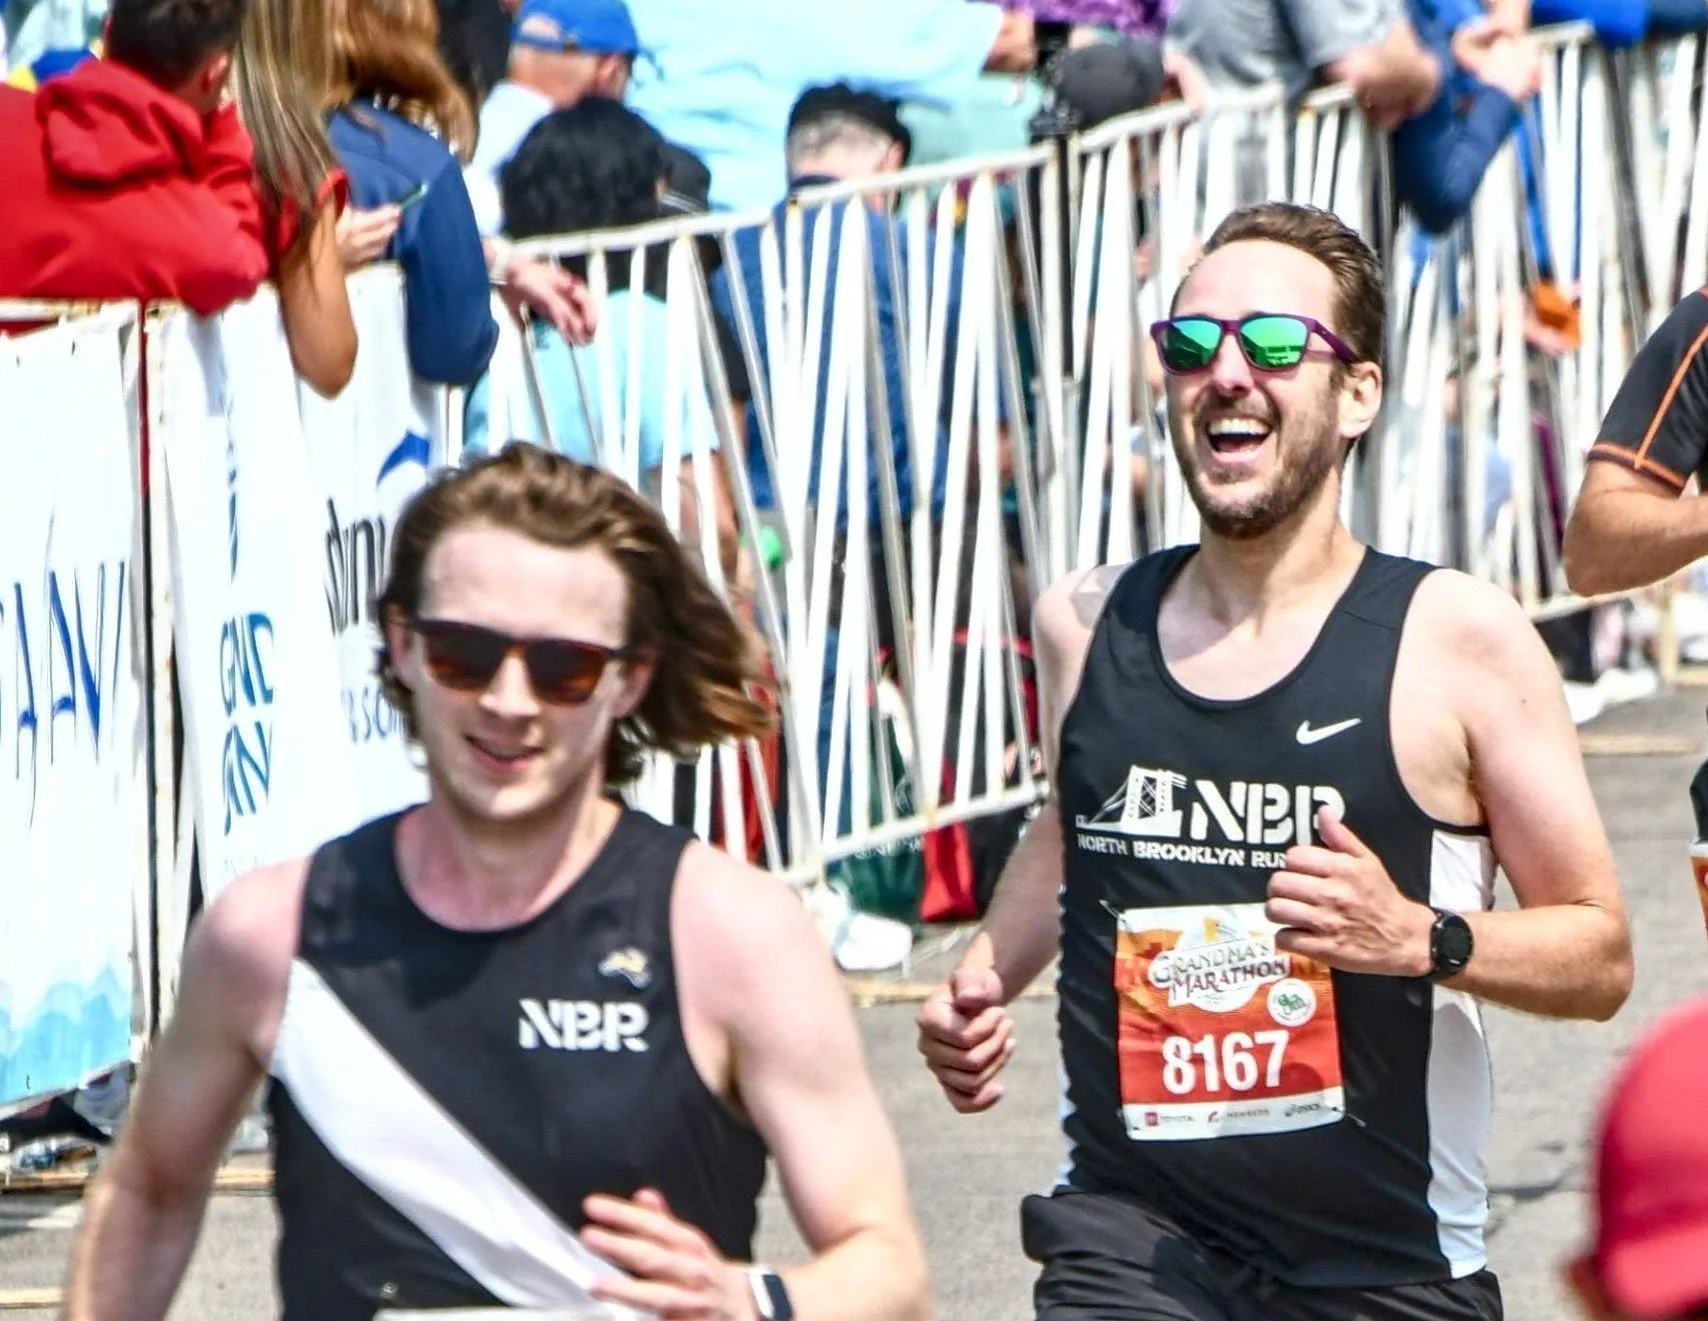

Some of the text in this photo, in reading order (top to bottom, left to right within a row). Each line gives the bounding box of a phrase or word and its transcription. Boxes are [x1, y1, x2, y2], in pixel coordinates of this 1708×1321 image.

[1077, 833, 1128, 855] NORTH
[1132, 840, 1245, 867] BROOKLYN
[1171, 957, 1287, 1000] MARATHON
[518, 998, 650, 1052] NBR
[1161, 1029, 1290, 1095] 8167
